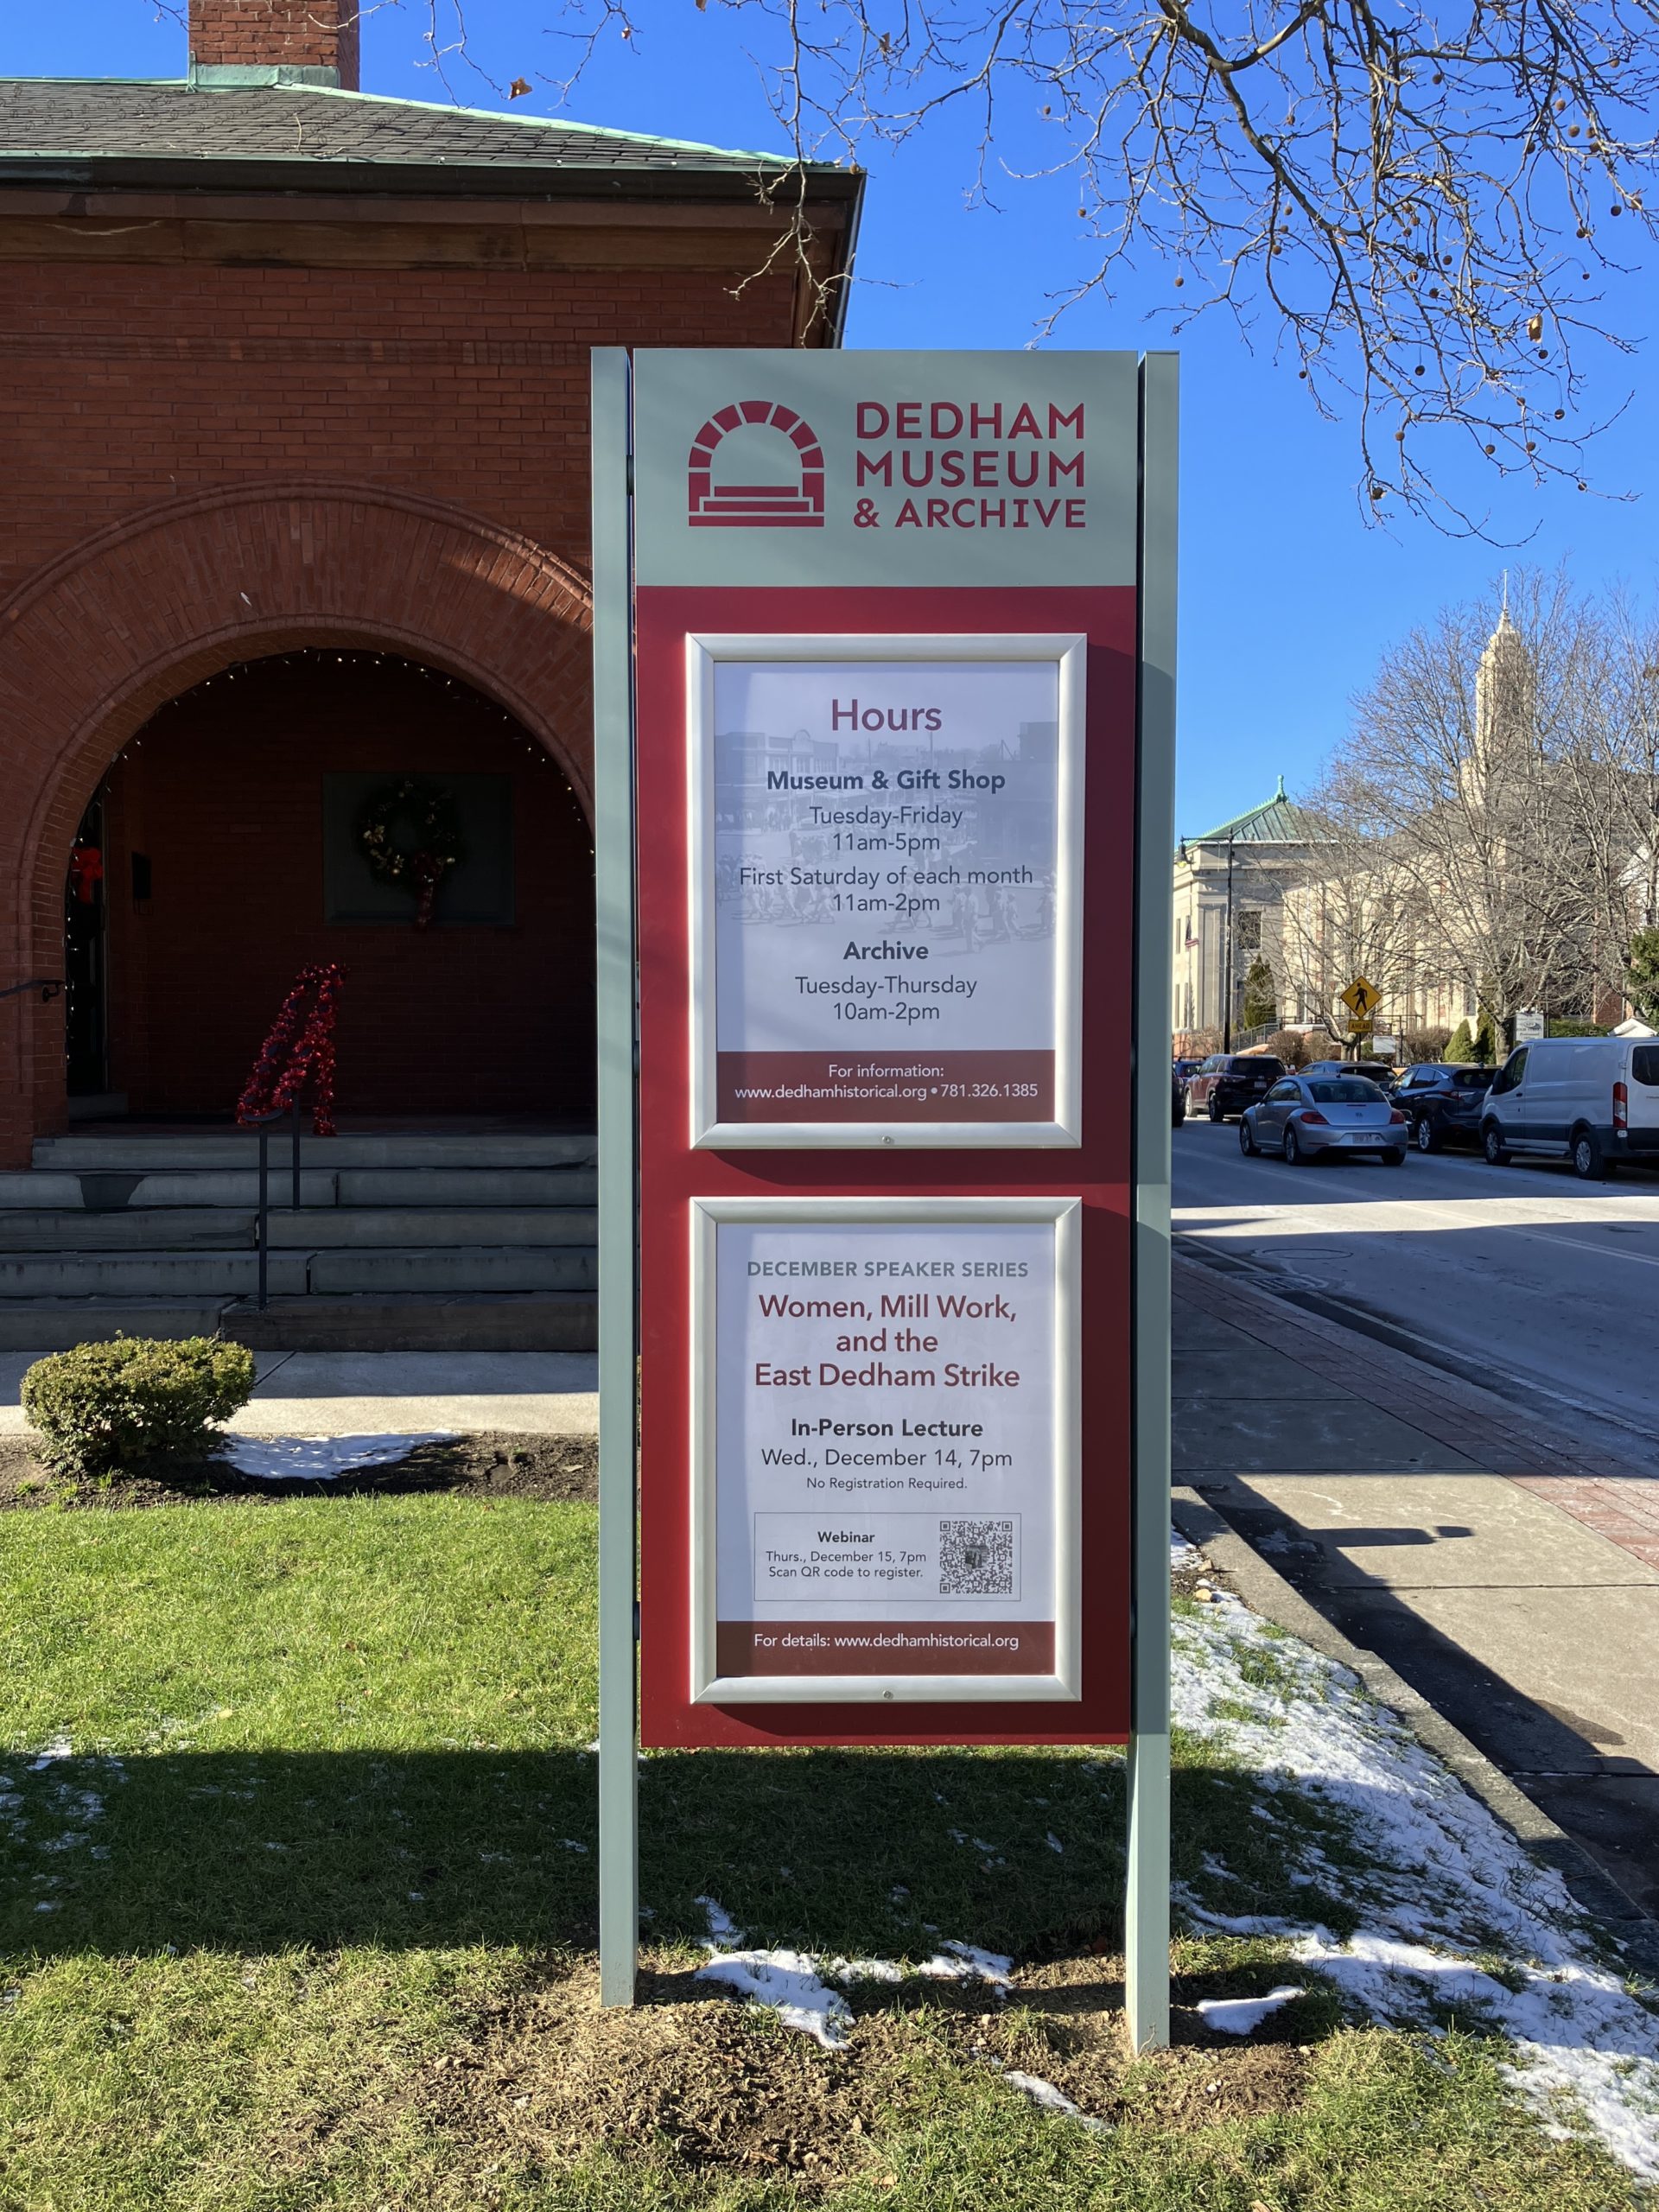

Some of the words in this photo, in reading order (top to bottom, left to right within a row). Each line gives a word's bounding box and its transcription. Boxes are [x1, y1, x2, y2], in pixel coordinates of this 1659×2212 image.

[856, 402, 1085, 440] DEDHAM
[856, 450, 1085, 487] MUSEUM
[853, 498, 880, 528] &
[894, 499, 1087, 528] ARCHIVE
[831, 698, 943, 732] Hours
[767, 771, 864, 791] Museum
[871, 771, 889, 791] &
[897, 769, 941, 791] Gift
[948, 769, 1006, 794] Shop
[809, 805, 963, 829] Tuesday-Friday
[832, 833, 940, 856] 11am-5pm
[740, 867, 784, 886] First
[790, 866, 880, 890] Saturday
[886, 866, 907, 886] of
[913, 866, 961, 885] each
[968, 865, 1033, 884] month
[833, 893, 940, 917] 11am-2pm
[843, 940, 930, 961] Archive
[795, 976, 978, 998] Tuesday-Thursday
[833, 1002, 940, 1026] 10am-2pm
[829, 1065, 853, 1078] For
[856, 1064, 944, 1078] information:
[734, 1084, 927, 1102] www.dedhamhistorical.org
[940, 1084, 1039, 1098] 781.326.1385
[747, 1262, 858, 1277] DECEMBER
[864, 1262, 955, 1277] SPEAKER
[962, 1262, 1029, 1278] SERIES
[759, 1294, 873, 1322] Women,
[880, 1294, 929, 1318] Mill
[937, 1294, 1017, 1322] Work,
[836, 1328, 887, 1352] and
[894, 1328, 939, 1352] the
[755, 1363, 811, 1386] East
[819, 1363, 936, 1387] Dedham
[944, 1363, 1020, 1387] Strike
[791, 1419, 893, 1437] In-Person
[902, 1419, 983, 1437] Lecture
[761, 1448, 817, 1468] Wed.,
[825, 1448, 927, 1466] December
[934, 1449, 963, 1469] 14,
[969, 1449, 1013, 1471] 7pm
[806, 1478, 825, 1490] No
[830, 1477, 904, 1491] Registration
[908, 1477, 968, 1491] Required.
[817, 1531, 875, 1543] Webinar
[766, 1551, 806, 1565] Thurs.,
[810, 1551, 874, 1563] December
[878, 1552, 897, 1565] 15,
[899, 1552, 927, 1566] 7pm
[768, 1567, 798, 1578] Scan
[801, 1567, 820, 1578] QR
[823, 1566, 855, 1578] code
[857, 1567, 870, 1578] to
[874, 1567, 923, 1580] register.
[754, 1634, 779, 1648] For
[781, 1633, 830, 1648] details:
[835, 1633, 1019, 1650] www.dedhamhistorical.org
